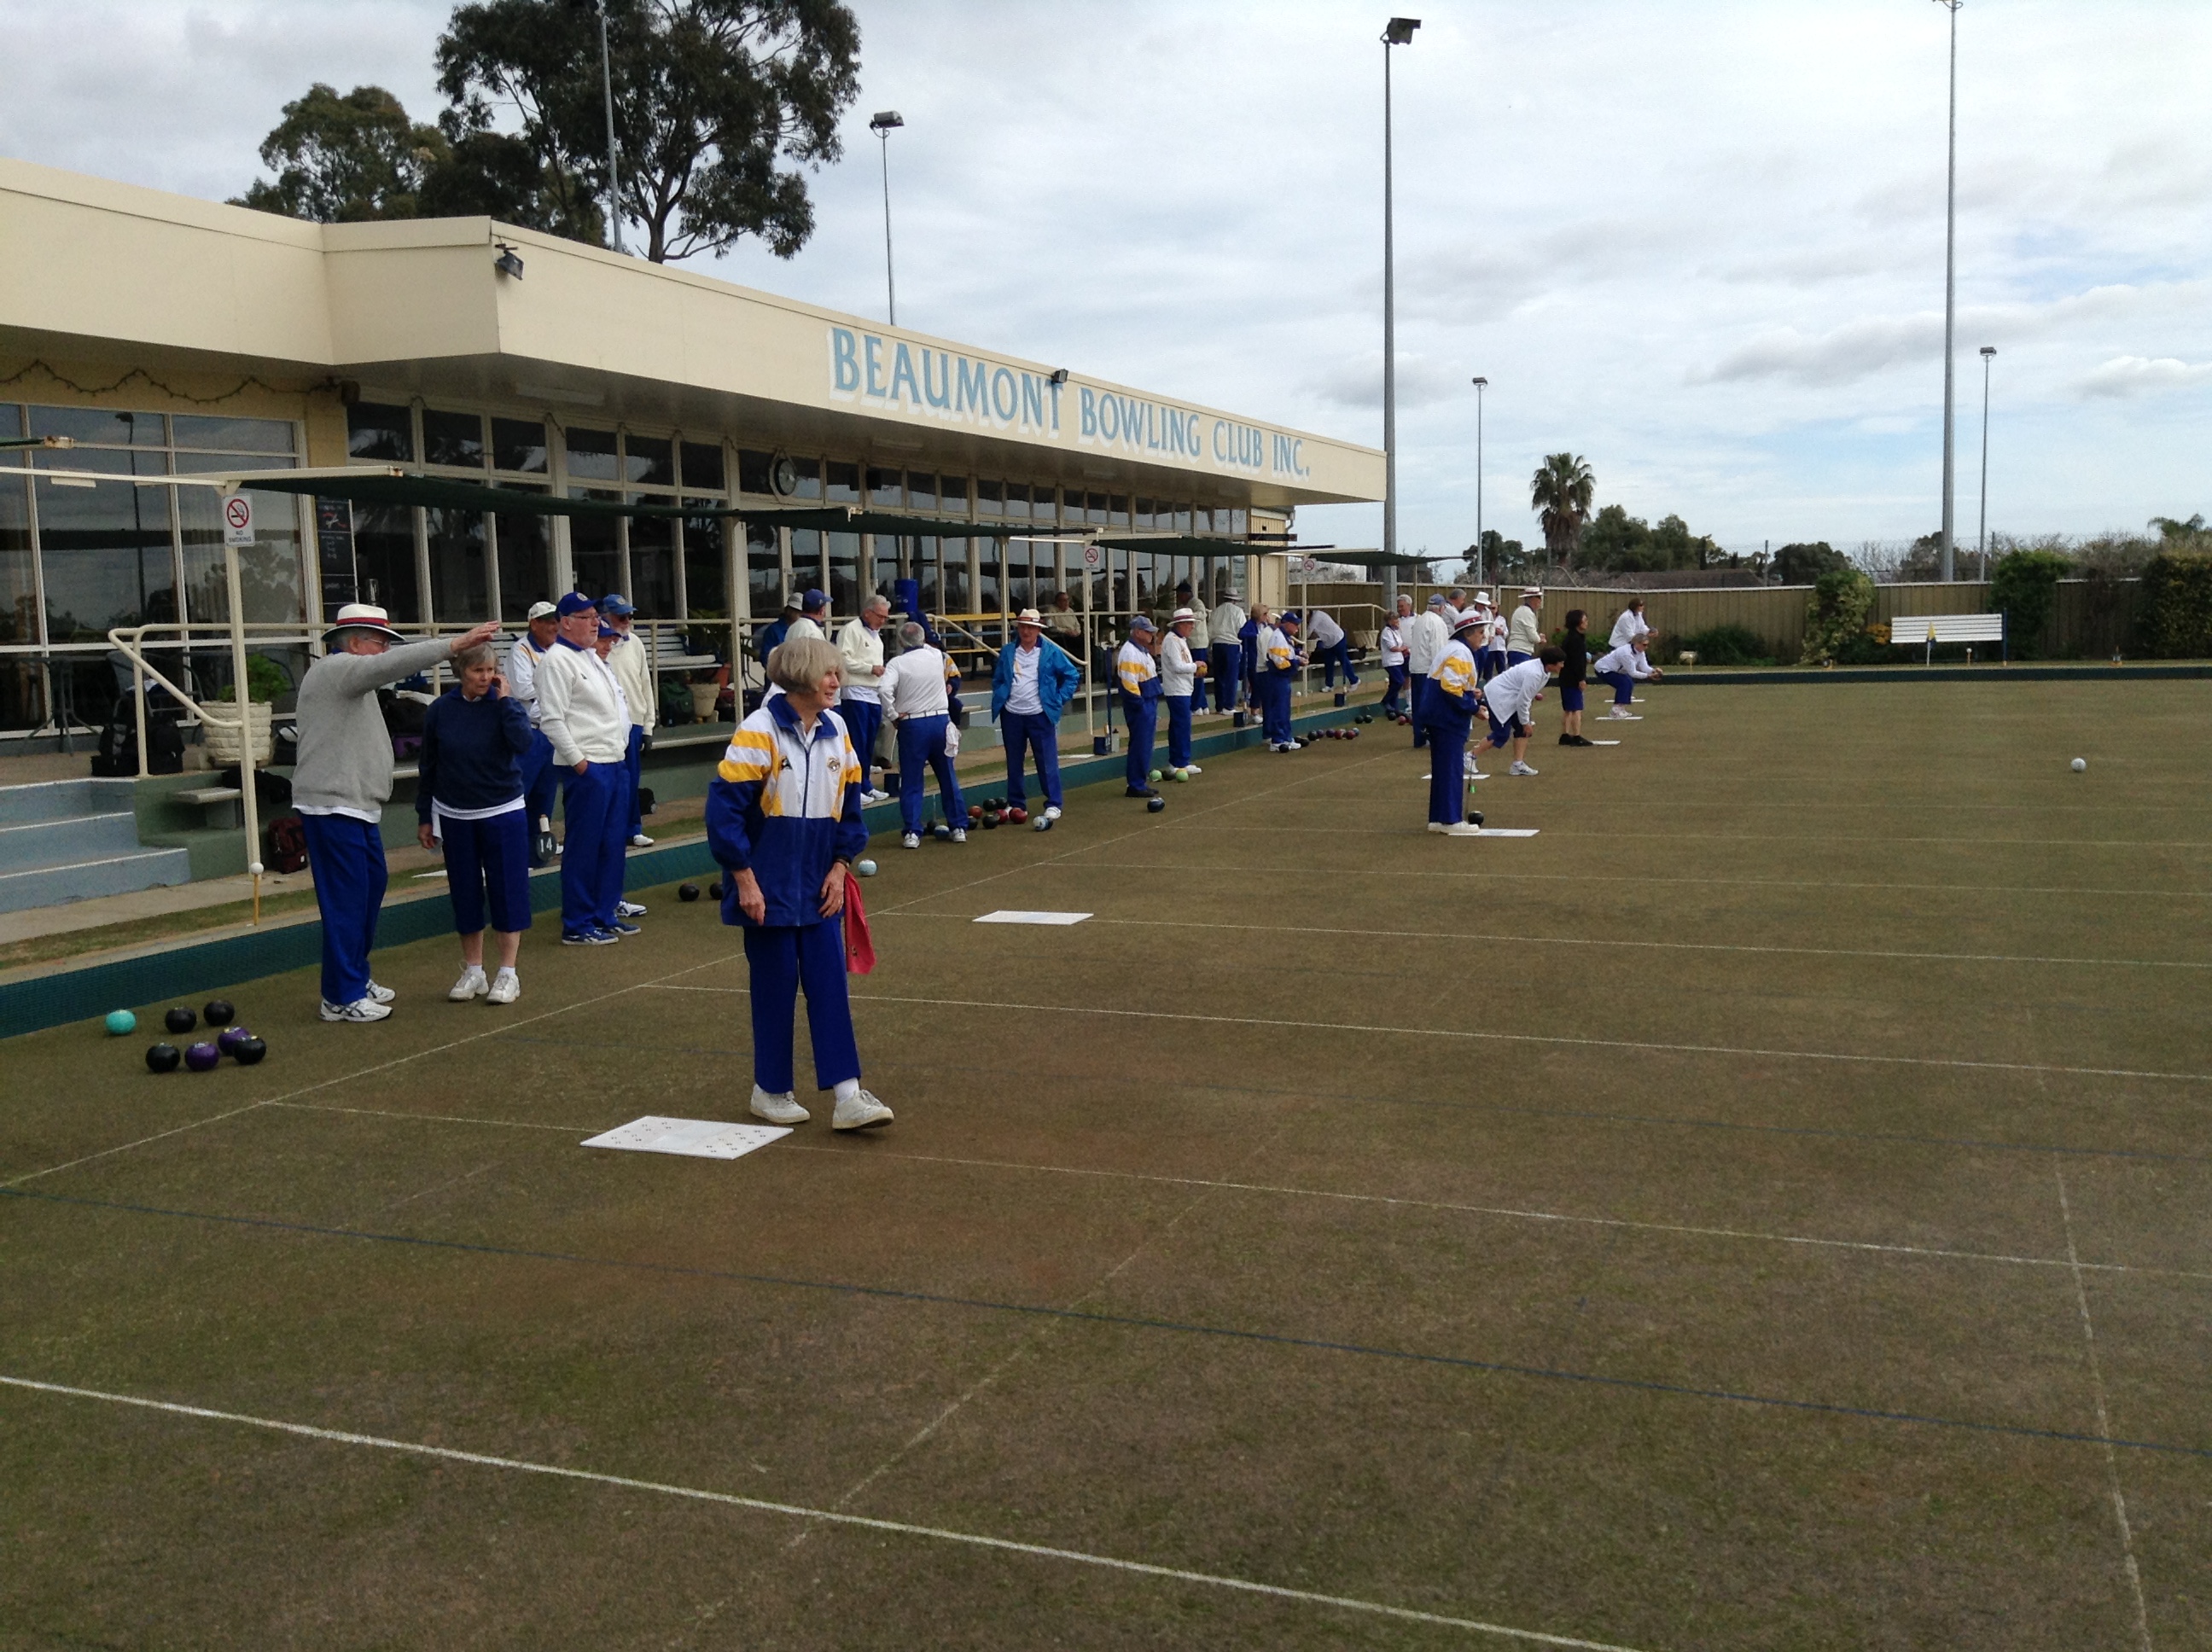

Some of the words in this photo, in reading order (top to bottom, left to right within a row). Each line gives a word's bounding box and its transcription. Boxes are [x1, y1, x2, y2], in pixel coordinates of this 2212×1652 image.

[828, 327, 1063, 438] BEAUMONT
[1079, 387, 1201, 461] BOWLING
[1213, 420, 1263, 471] CLUB
[1273, 433, 1310, 480] INC.
[540, 837, 552, 852] 14
